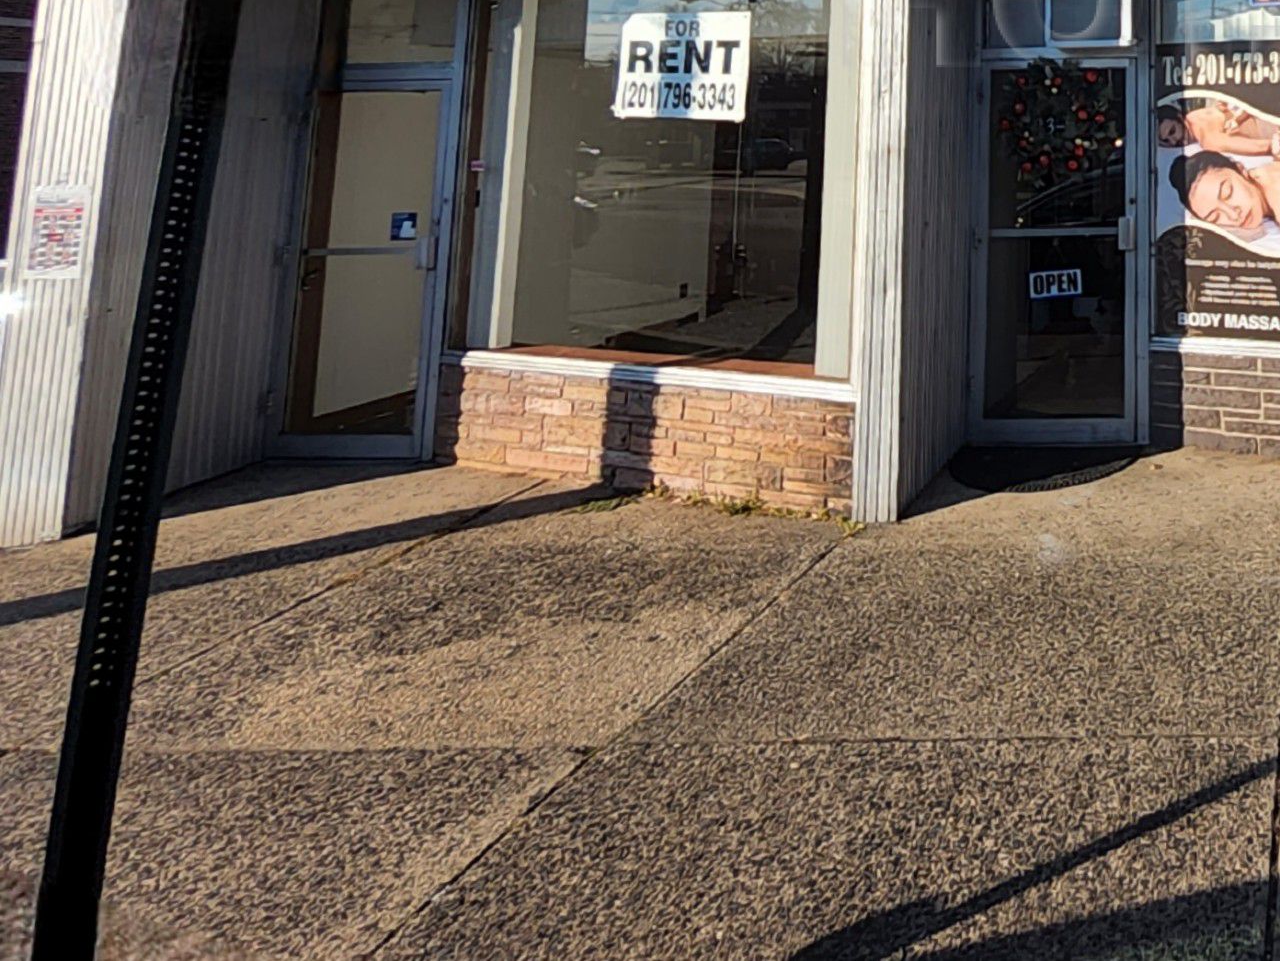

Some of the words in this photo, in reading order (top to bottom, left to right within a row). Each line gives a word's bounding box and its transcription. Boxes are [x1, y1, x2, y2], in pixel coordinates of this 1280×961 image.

[664, 20, 700, 37] FOR
[627, 40, 741, 75] RENT
[1162, 55, 1193, 86] Tel:
[1032, 271, 1079, 296] OPEN
[1177, 311, 1222, 328] BODY
